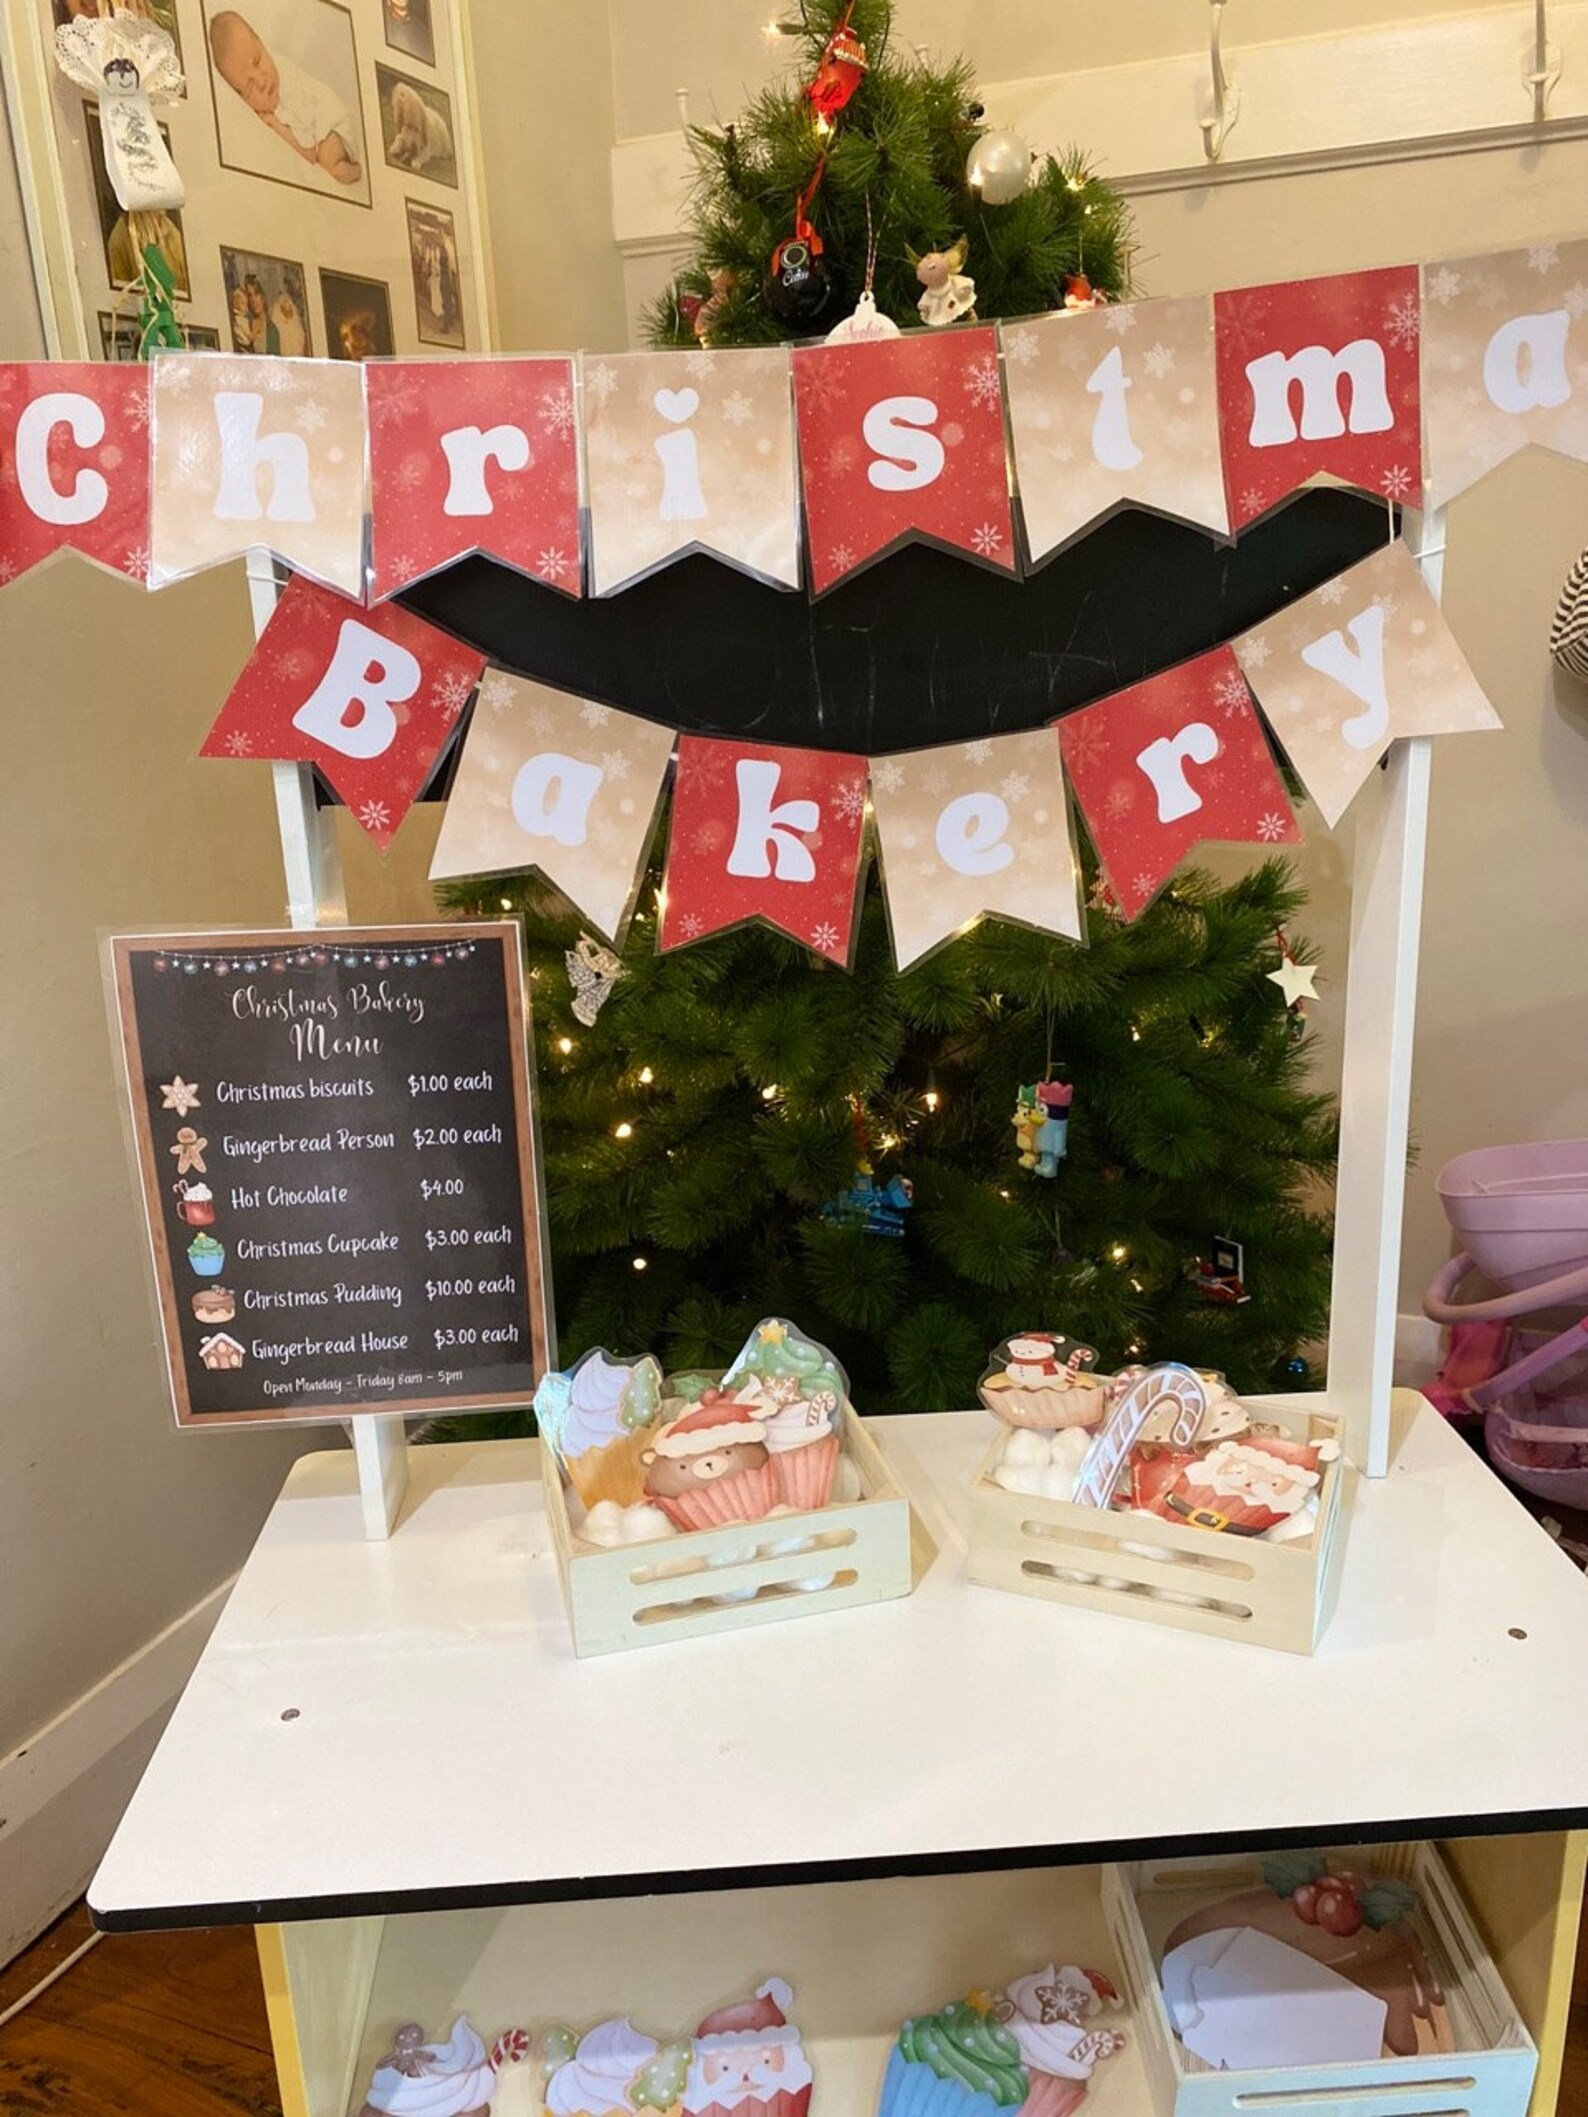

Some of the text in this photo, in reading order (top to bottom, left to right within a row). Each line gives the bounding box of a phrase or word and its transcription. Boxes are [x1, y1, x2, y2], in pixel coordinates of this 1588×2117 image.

[292, 604, 1390, 882] Bakery
[232, 981, 424, 1024] Christmas Bakery
[290, 1018, 383, 1062] Menu
[217, 1071, 493, 1105] Christmas biscuits $1.00 each
[223, 1124, 502, 1163] Gingerbread Person $2.00 each
[231, 1179, 464, 1210] Hot Chocolate $4.00
[237, 1225, 512, 1261] Christmas Cupcake $3.00 each
[244, 1275, 516, 1310] Christmas Pudding $10.00 each
[252, 1324, 519, 1366] Gingerbread House $3.00 each
[263, 1380, 292, 1397] Open
[296, 1378, 342, 1394] Monday
[357, 1375, 395, 1390] Friday
[438, 1371, 463, 1385] 5pm
